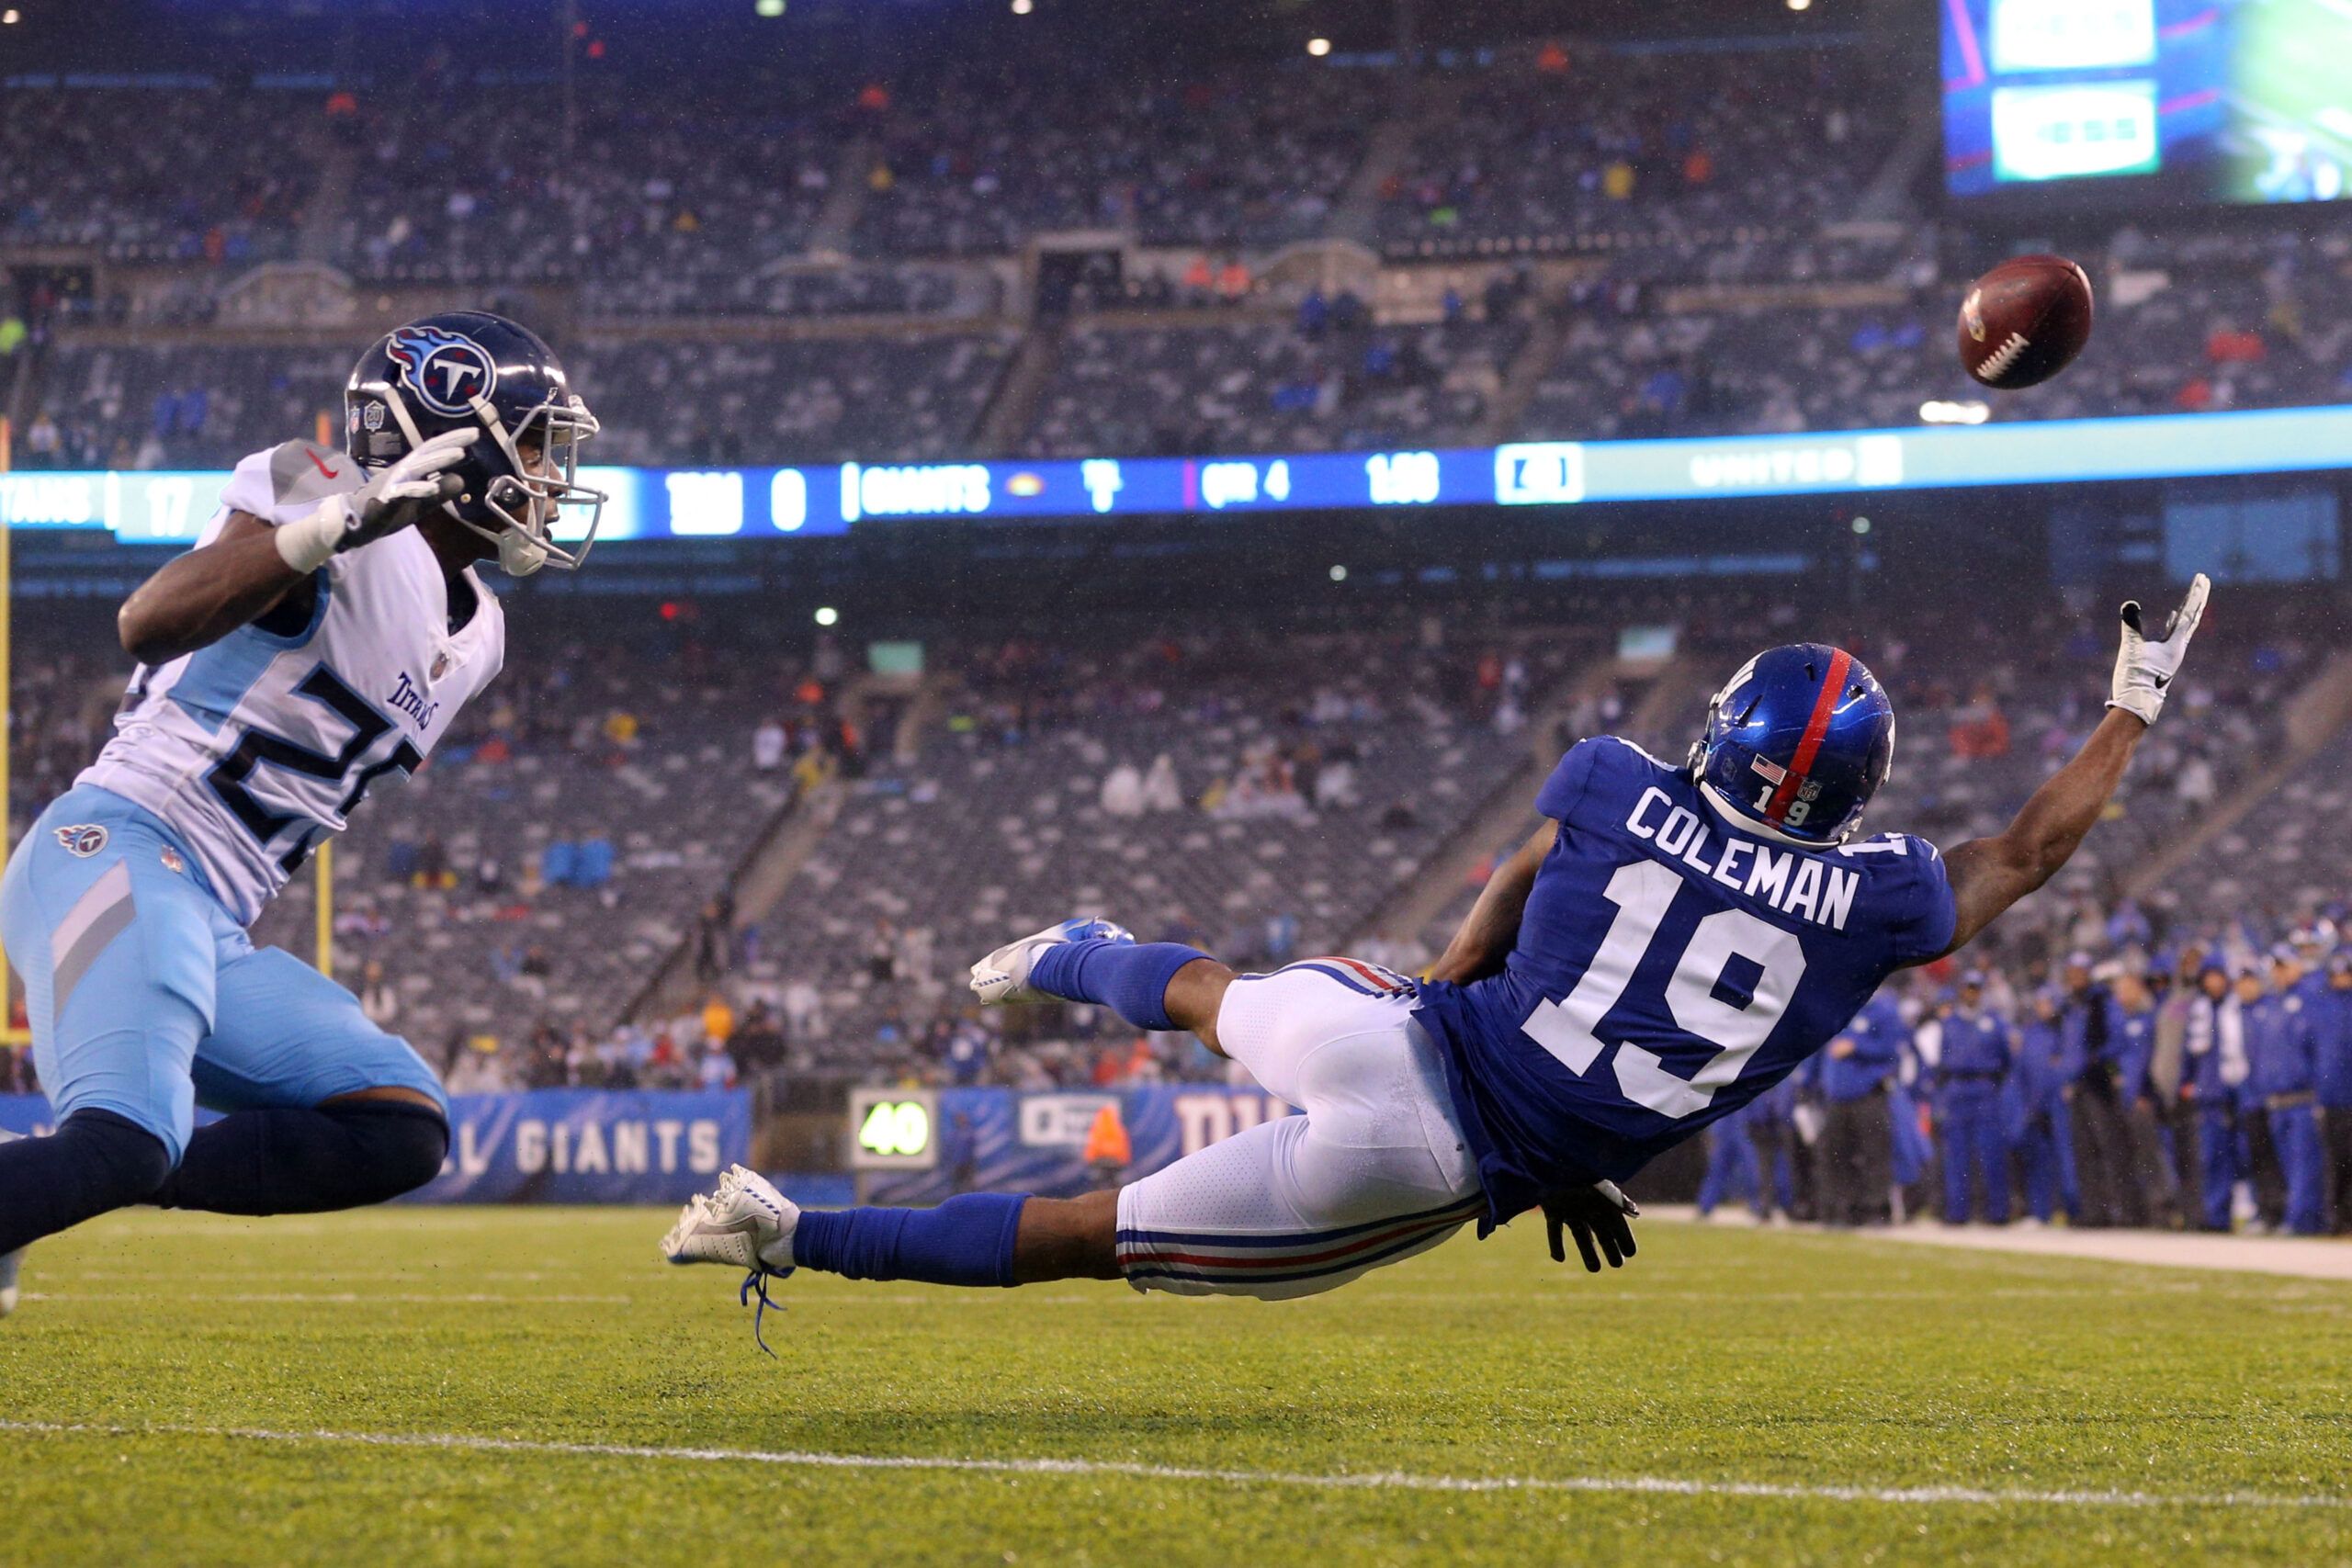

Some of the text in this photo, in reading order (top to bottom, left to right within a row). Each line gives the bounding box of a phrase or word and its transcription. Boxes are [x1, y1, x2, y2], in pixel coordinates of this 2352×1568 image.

[861, 465, 990, 514] GIANTS
[1690, 449, 1854, 487] UNITED
[146, 477, 193, 536] 17
[1625, 786, 1860, 931] COLEMAN
[1520, 859, 1807, 1120] 19
[515, 1118, 721, 1176] GIANTS
[858, 1101, 929, 1156] 40
